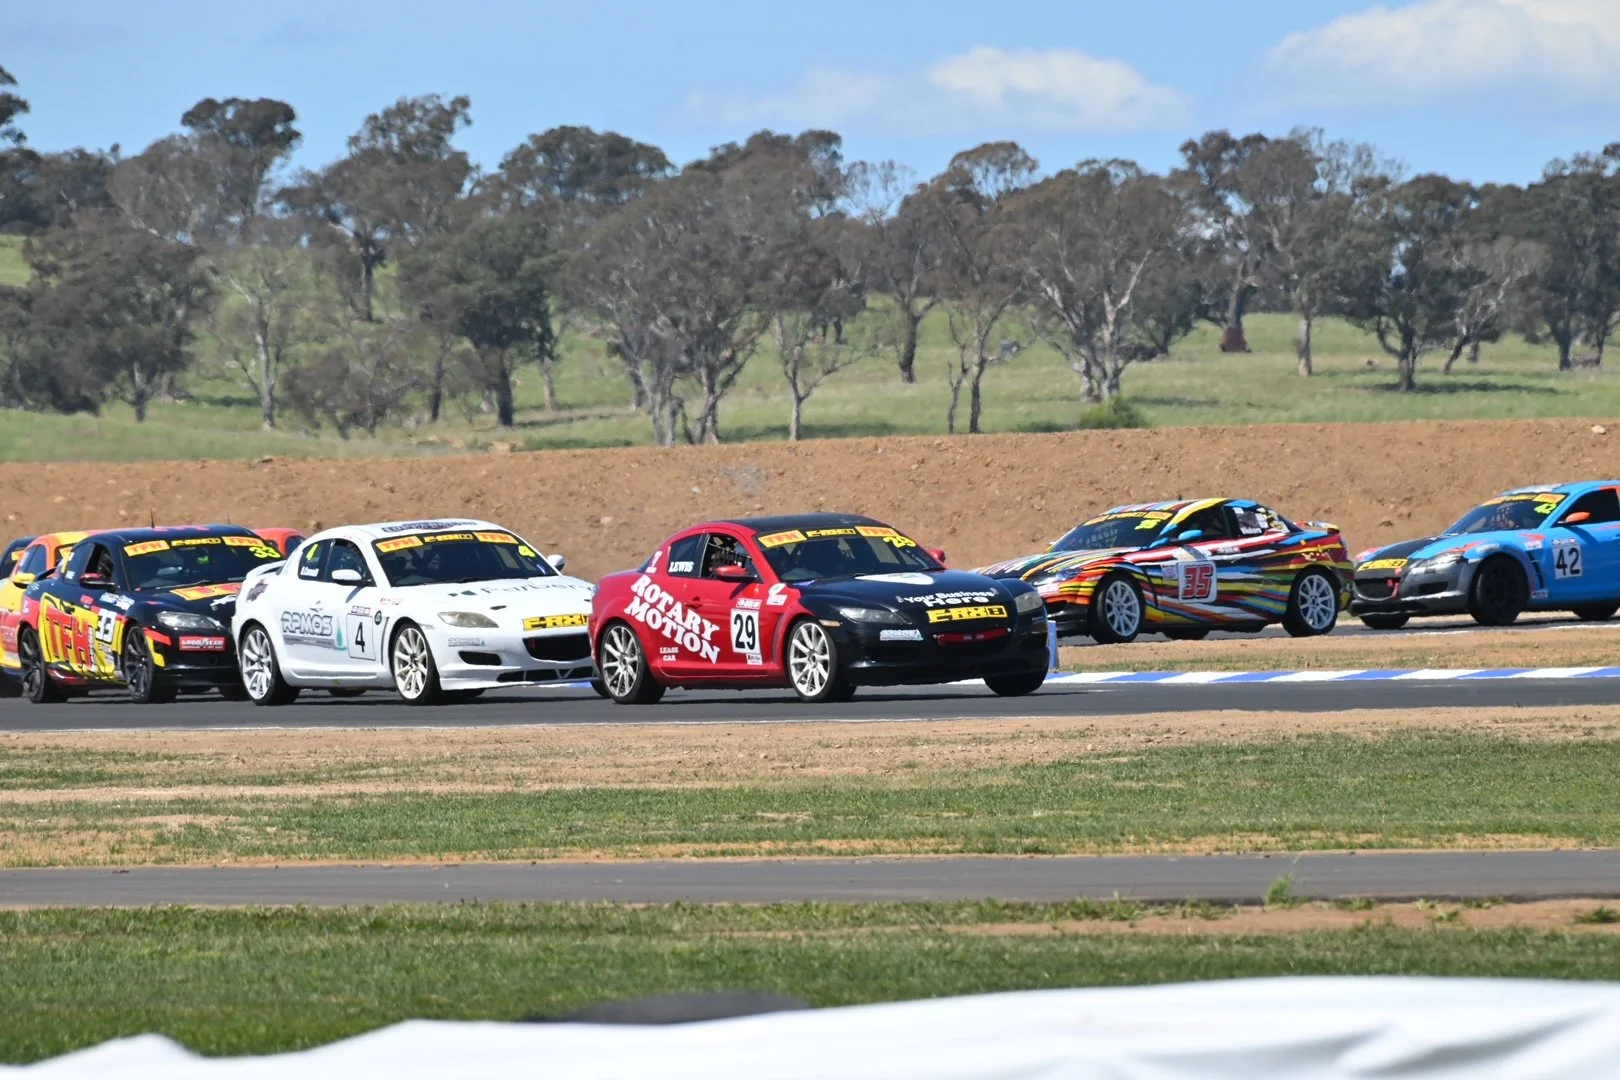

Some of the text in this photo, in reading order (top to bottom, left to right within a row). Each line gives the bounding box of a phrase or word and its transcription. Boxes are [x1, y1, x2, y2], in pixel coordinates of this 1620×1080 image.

[249, 545, 281, 558] 33
[882, 535, 916, 548] 29
[668, 561, 694, 573] LEWIS
[1556, 547, 1580, 576] 42
[1182, 564, 1213, 599] 35
[631, 574, 720, 641] ROTARY
[904, 590, 995, 603] Your Business
[923, 596, 989, 607] Here
[281, 610, 333, 636] RPMOS
[355, 621, 365, 652] 4
[623, 595, 721, 665] MOTION
[734, 614, 756, 650] 29
